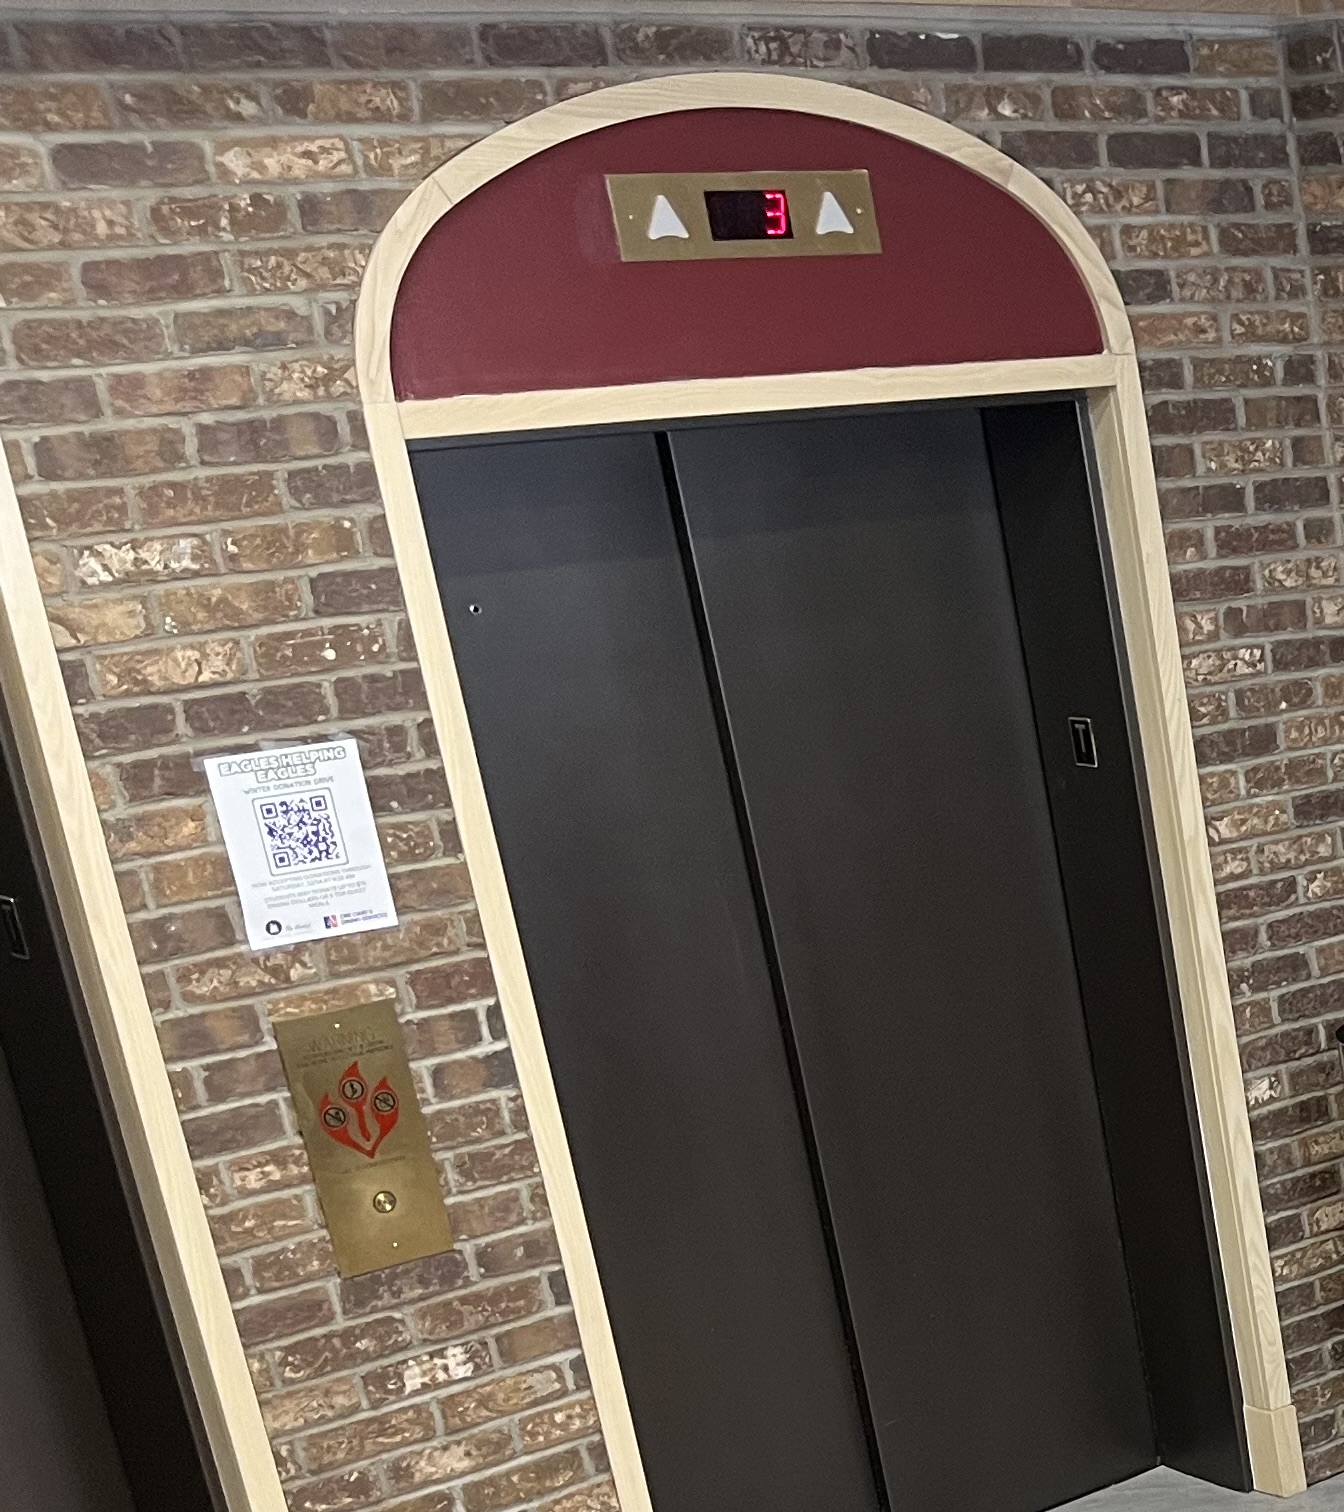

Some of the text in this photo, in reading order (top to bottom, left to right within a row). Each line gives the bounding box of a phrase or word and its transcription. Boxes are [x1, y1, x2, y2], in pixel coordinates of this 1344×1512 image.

[765, 192, 786, 235] 3
[217, 746, 347, 777] EAGLES HELPING
[255, 762, 317, 784] EAGLES
[243, 775, 335, 795] WINTER DONATION DRIVE
